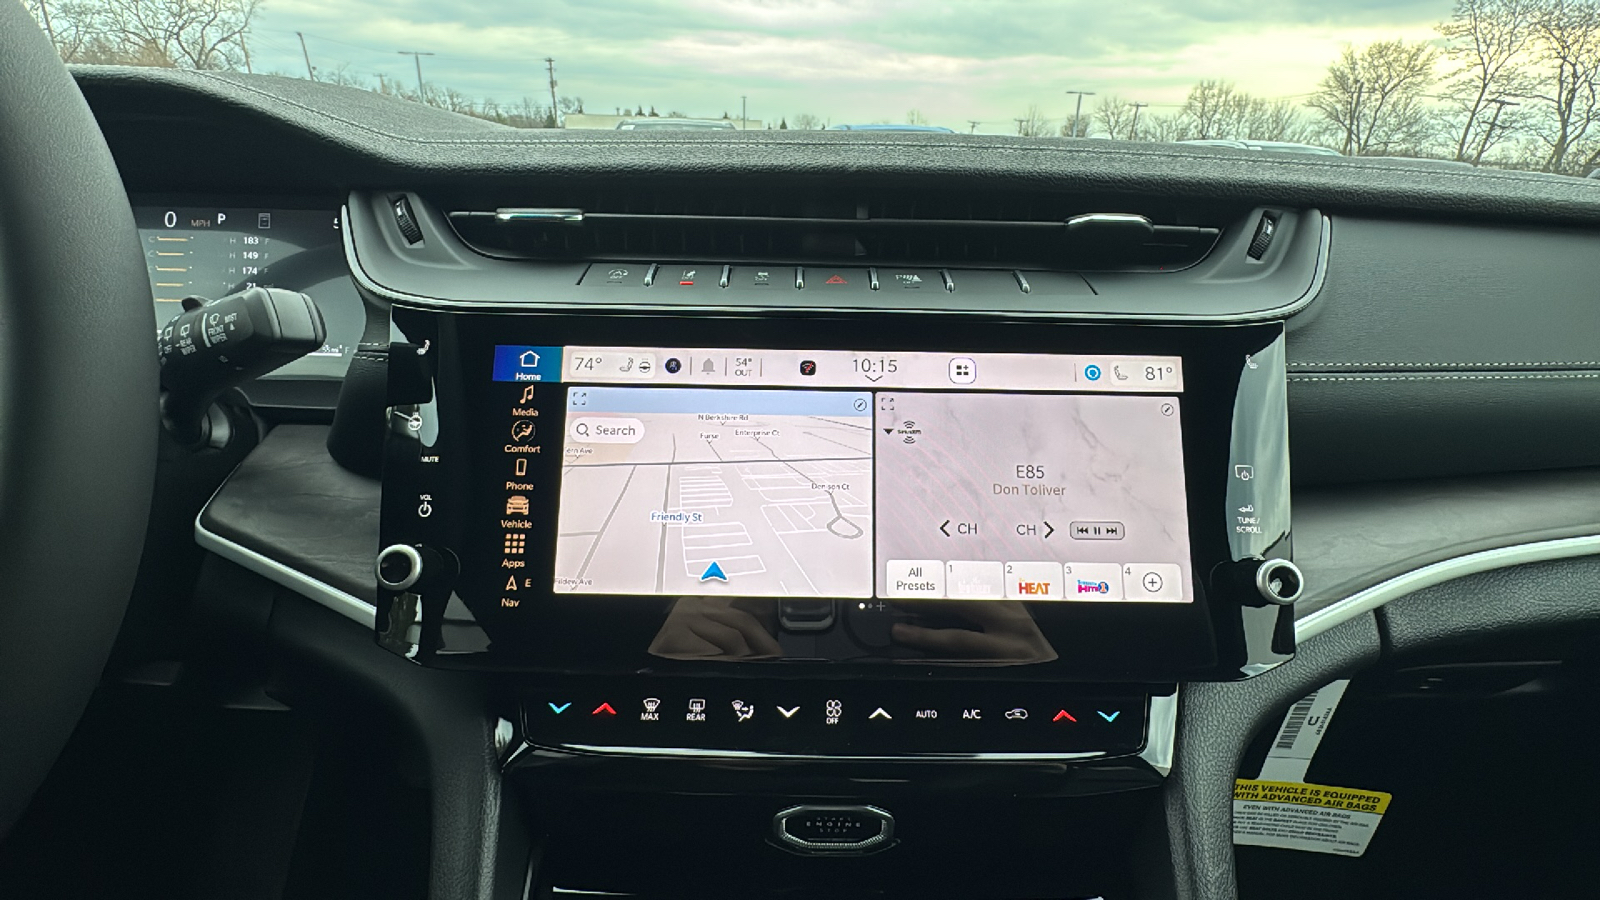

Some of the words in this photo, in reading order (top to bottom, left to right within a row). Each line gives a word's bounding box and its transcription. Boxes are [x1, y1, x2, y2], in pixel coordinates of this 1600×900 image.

[191, 220, 211, 228] MPH
[217, 213, 226, 225] P
[243, 236, 259, 245] 183
[243, 251, 259, 259] 149
[242, 266, 258, 275] 174
[207, 324, 224, 337] FRONT
[574, 357, 602, 371] 74°
[853, 358, 897, 374] 10:15
[515, 371, 541, 381] Home
[735, 368, 752, 377] OUT
[1145, 365, 1173, 381] 81°
[512, 407, 539, 417] Media
[595, 424, 637, 436] Search
[504, 444, 541, 454] Comfort
[420, 455, 440, 463] MUTE
[1016, 465, 1045, 479] E85
[505, 481, 534, 492] Phone
[993, 483, 1019, 496] Don
[1023, 483, 1067, 496] Toliver
[650, 512, 691, 524] Friendly
[691, 512, 703, 523] St
[501, 519, 532, 530] Vehicle
[957, 523, 978, 535] CH
[1236, 525, 1263, 534] SCROLL
[1016, 524, 1037, 536] CH
[501, 558, 525, 570] Apps
[1006, 564, 1013, 574] 2
[908, 567, 923, 578] All
[948, 565, 953, 575] 1
[1065, 565, 1073, 575] 3
[1124, 566, 1132, 576] 4
[524, 578, 532, 588] E
[896, 580, 936, 592] Presets
[1018, 582, 1051, 595] HEAT
[501, 597, 521, 608] Nav
[640, 712, 660, 721] MAX
[686, 712, 706, 721] REAR
[916, 709, 938, 719] AUTO
[962, 709, 982, 719] A/C
[826, 716, 840, 725] OFF
[1235, 784, 1259, 792] THIS
[1261, 785, 1308, 796] VEHICLE
[1309, 789, 1321, 797] IS
[1323, 791, 1381, 804] EQUIPPED
[1261, 793, 1322, 805] ADVANCED
[1323, 799, 1344, 808] AIR
[1346, 801, 1378, 812] BAGS
[1280, 807, 1319, 816] ADVANCED
